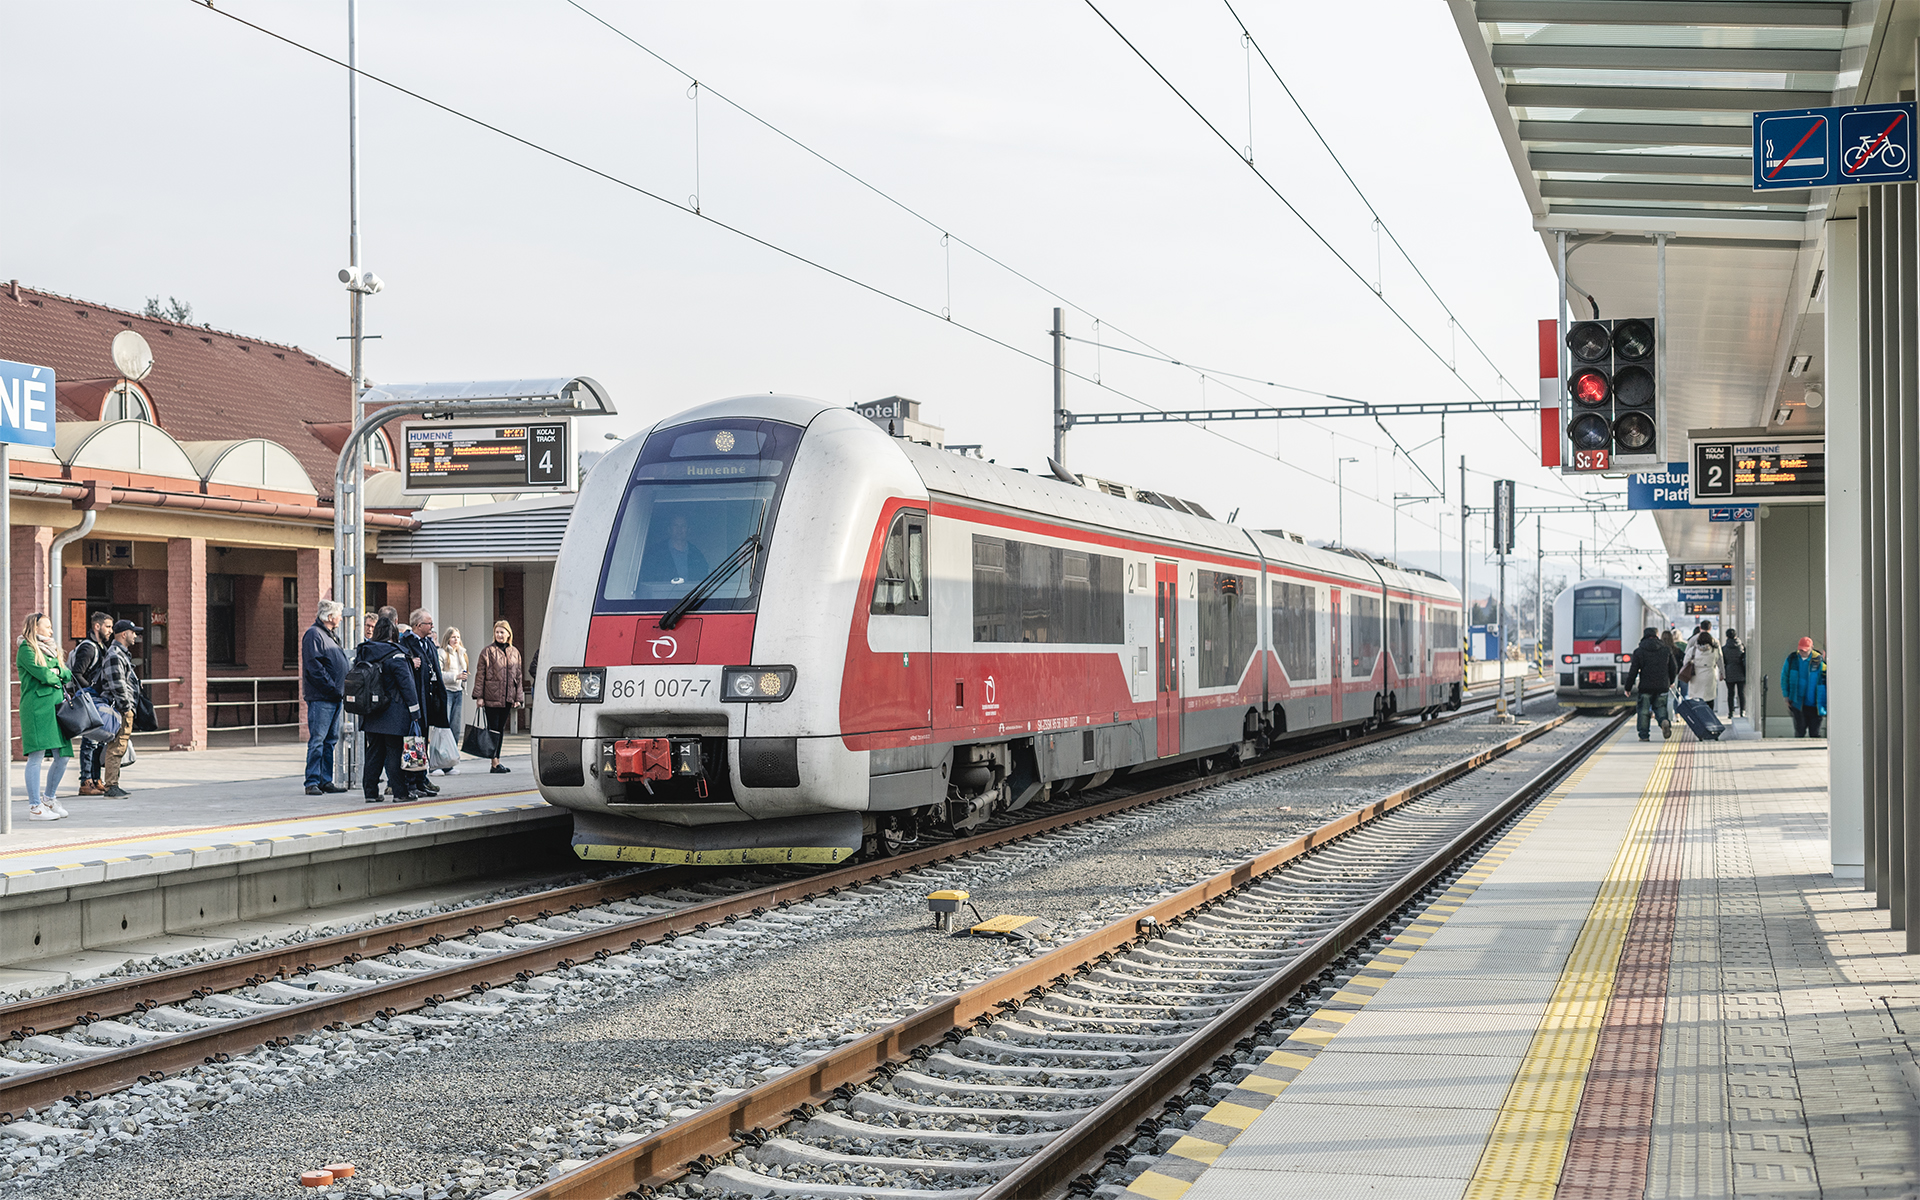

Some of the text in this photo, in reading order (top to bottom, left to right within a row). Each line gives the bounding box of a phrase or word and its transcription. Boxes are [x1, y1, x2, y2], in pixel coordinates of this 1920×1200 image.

[0, 367, 47, 432] NÉ
[854, 403, 898, 418] hotel
[410, 430, 453, 441] HUMENNÉ
[1736, 445, 1780, 454] HUMENNÉ
[538, 450, 553, 474] 4
[1576, 451, 1604, 468] Sc 2
[686, 462, 746, 476] Humenné
[1708, 465, 1722, 487] 2
[1127, 563, 1134, 594] 2
[1189, 571, 1195, 598] 2
[1673, 572, 1681, 583] 2
[612, 679, 711, 698] 861 007-7
